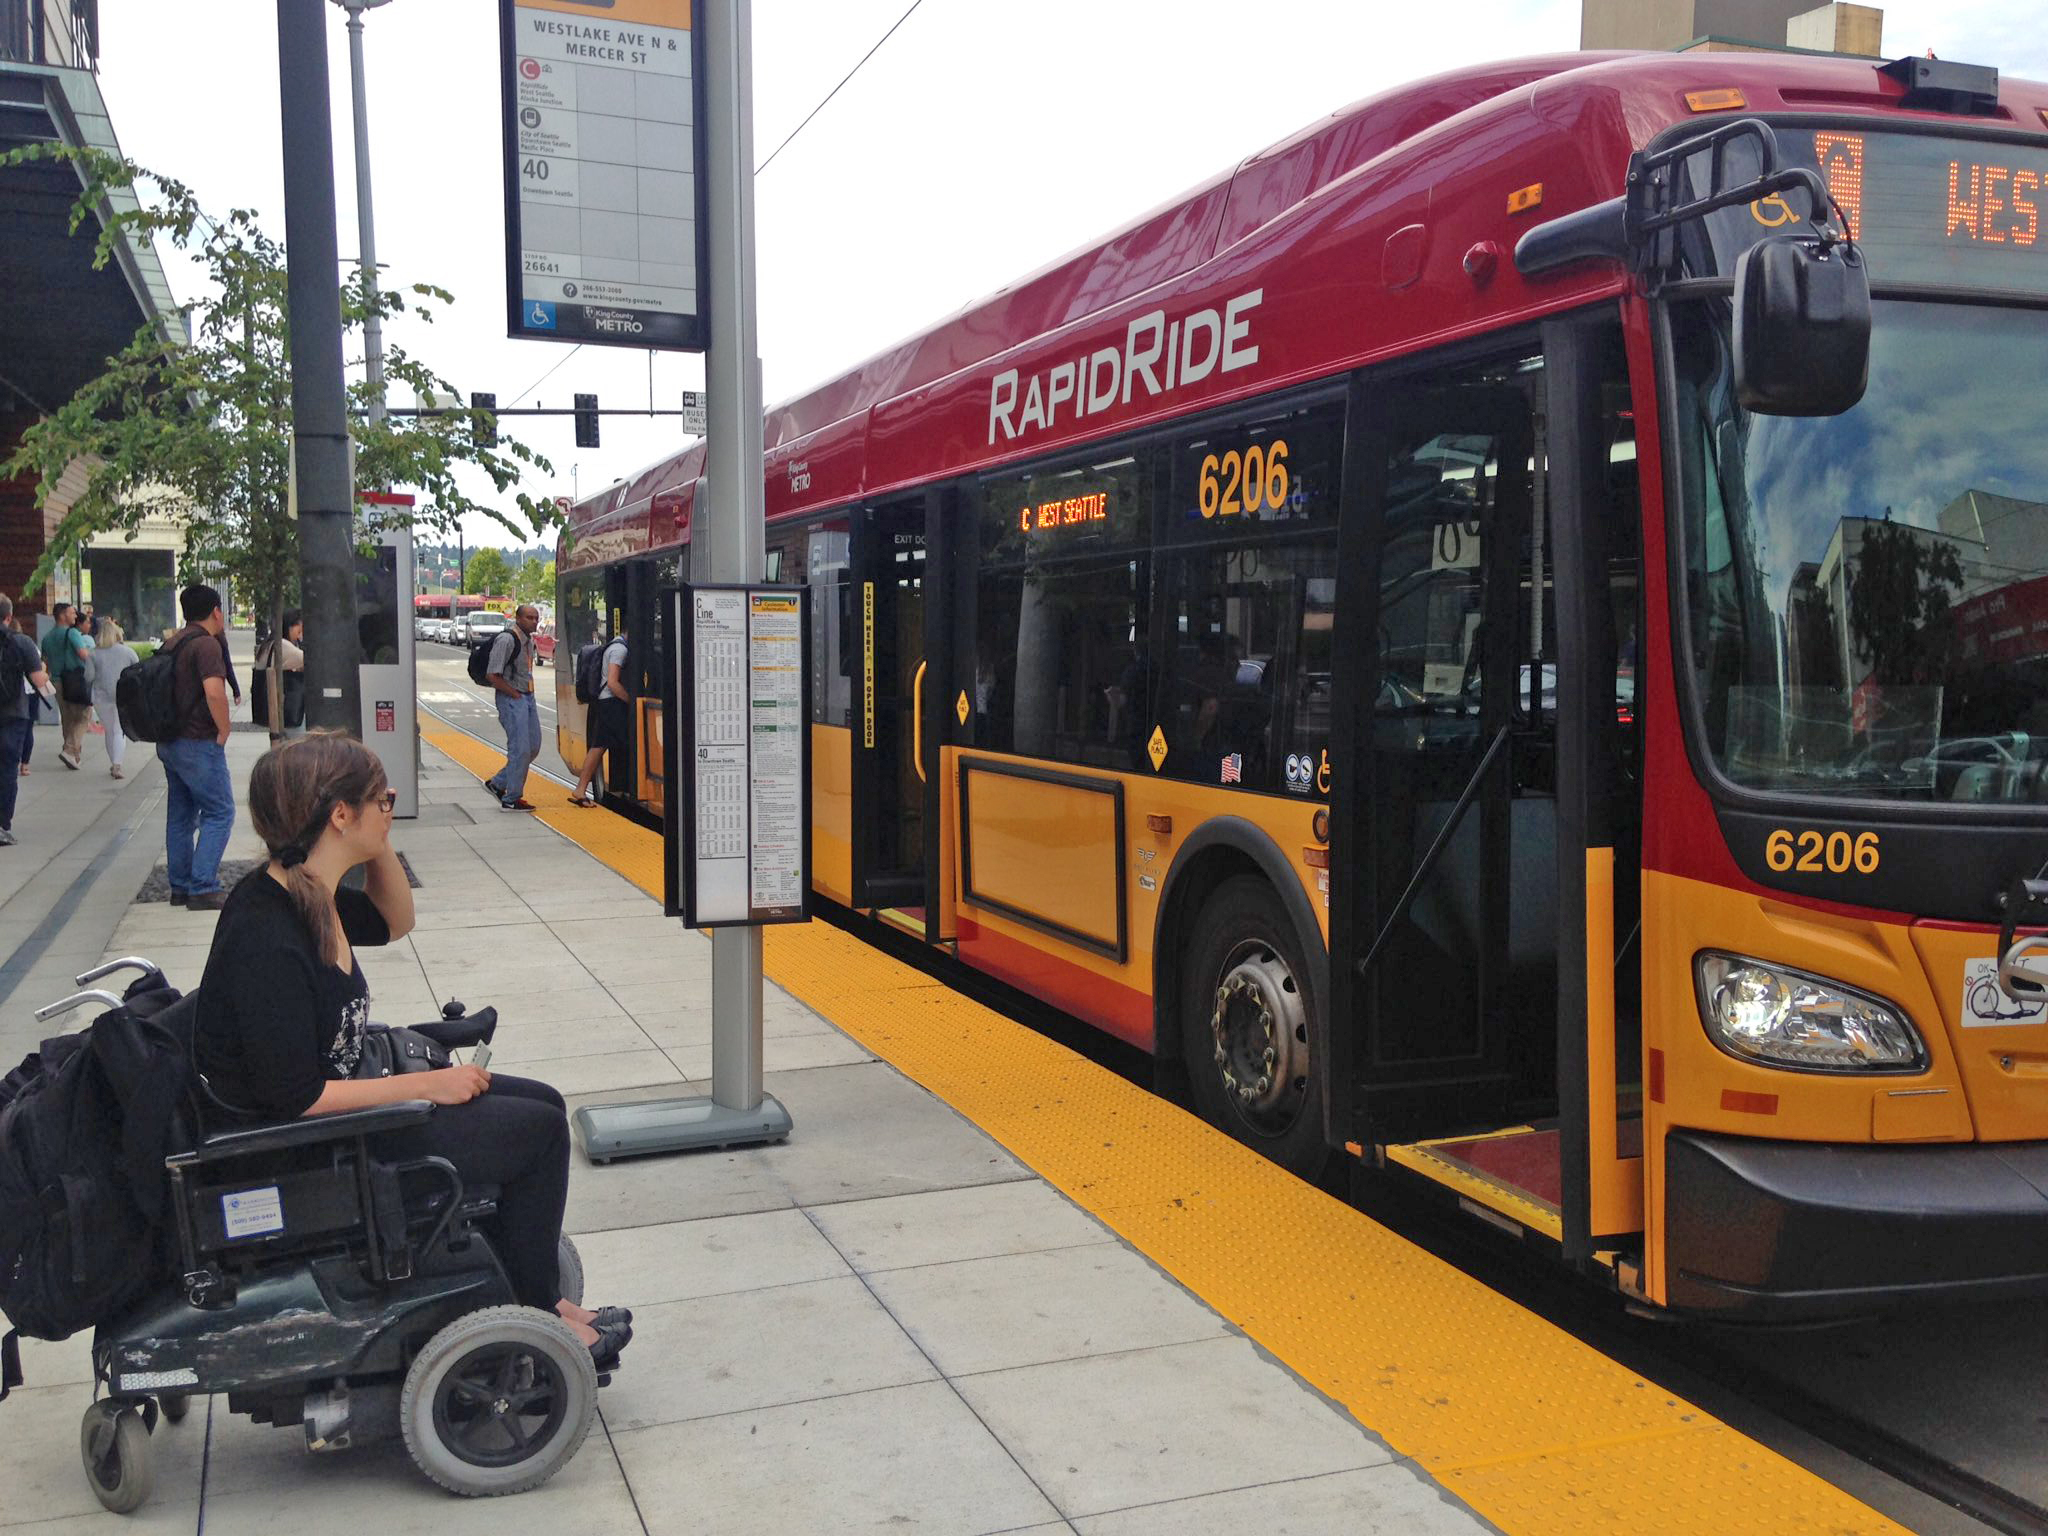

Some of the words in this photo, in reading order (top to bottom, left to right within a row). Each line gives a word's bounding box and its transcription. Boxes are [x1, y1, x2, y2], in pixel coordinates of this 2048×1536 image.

[534, 20, 611, 42] WESTLAKE
[618, 32, 645, 47] AVE
[651, 36, 661, 49] N
[668, 39, 677, 51] &
[566, 42, 625, 62] MERCER
[631, 51, 647, 65] ST
[541, 132, 560, 140] Seattle
[523, 159, 549, 180] 40
[522, 186, 553, 195] Downtown
[554, 189, 574, 198] Seattle
[1947, 162, 2048, 244] WES
[525, 261, 559, 273] 26641
[595, 309, 611, 319] King
[611, 311, 634, 321] County
[595, 319, 643, 333] METRO
[791, 472, 811, 493] METRO
[1199, 439, 1289, 519] 6206
[1022, 508, 1030, 531] C
[1038, 502, 1062, 528] WEST
[1064, 493, 1106, 523] SEATTLE
[894, 534, 912, 544] EXIT
[696, 597, 702, 609] C
[696, 608, 714, 619] Line
[866, 668, 872, 682] TO
[698, 748, 708, 759] 40
[1765, 829, 1880, 874] 6206
[1977, 963, 1989, 973] OK
